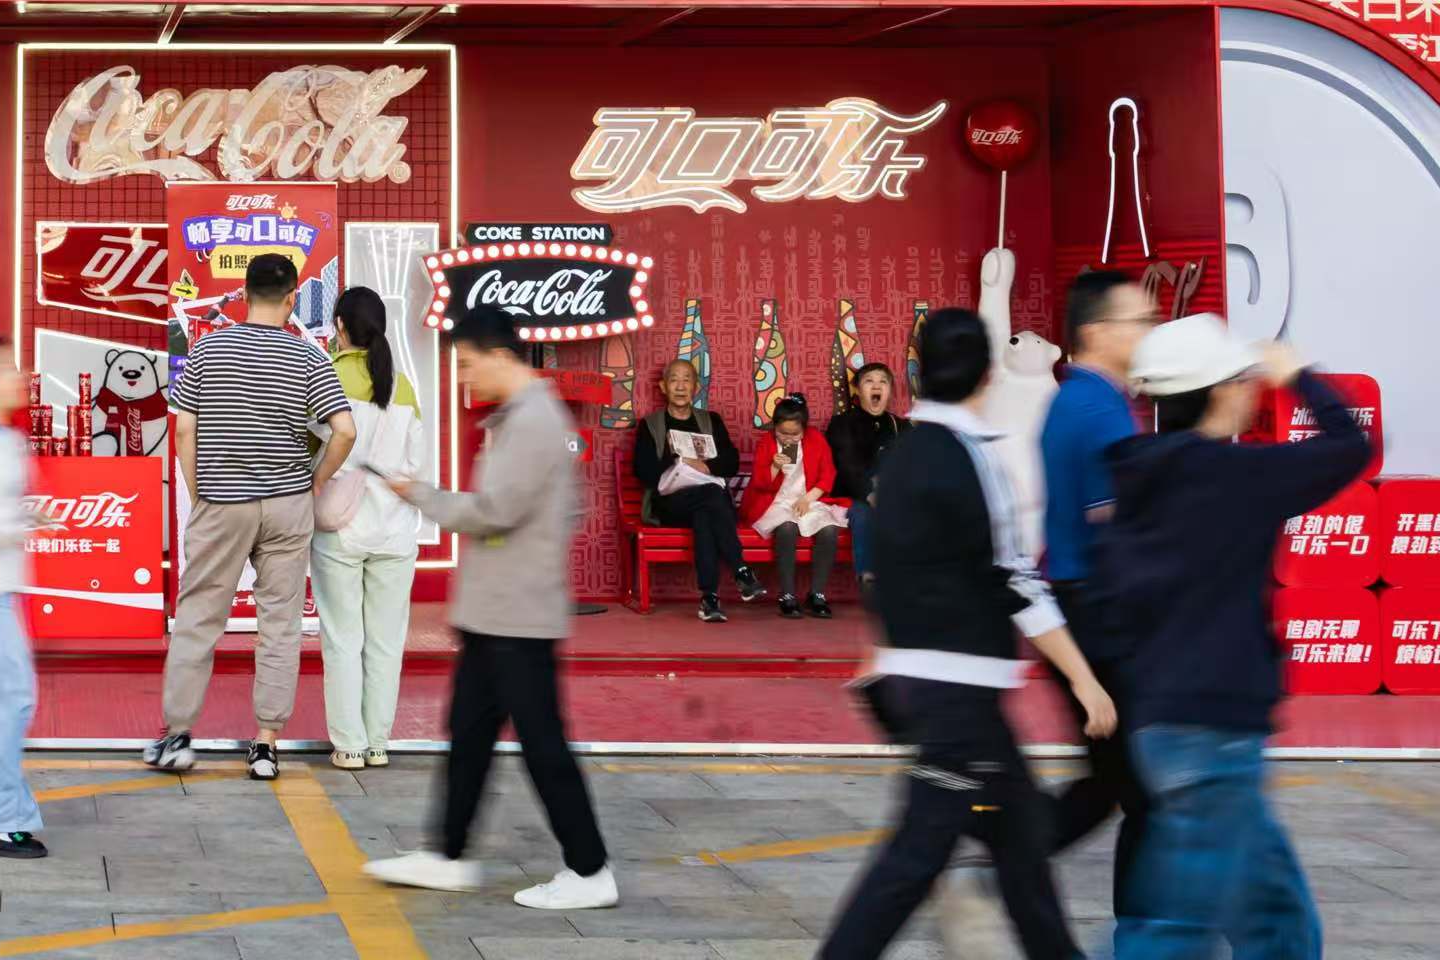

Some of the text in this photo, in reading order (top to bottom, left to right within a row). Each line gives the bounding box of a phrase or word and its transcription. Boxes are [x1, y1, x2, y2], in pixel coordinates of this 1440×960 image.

[45, 65, 427, 184] Coca-Cola
[971, 127, 1024, 145] 可口可乐
[571, 97, 950, 214] 可口可乐
[226, 194, 278, 211] 可口可乐
[187, 216, 314, 247] 畅享可口可乐
[474, 226, 605, 241] COKE STATION
[466, 268, 614, 317] Coca-Cola
[24, 538, 121, 553] 让我们乐在一起
[1290, 535, 1370, 555] 可乐一口
